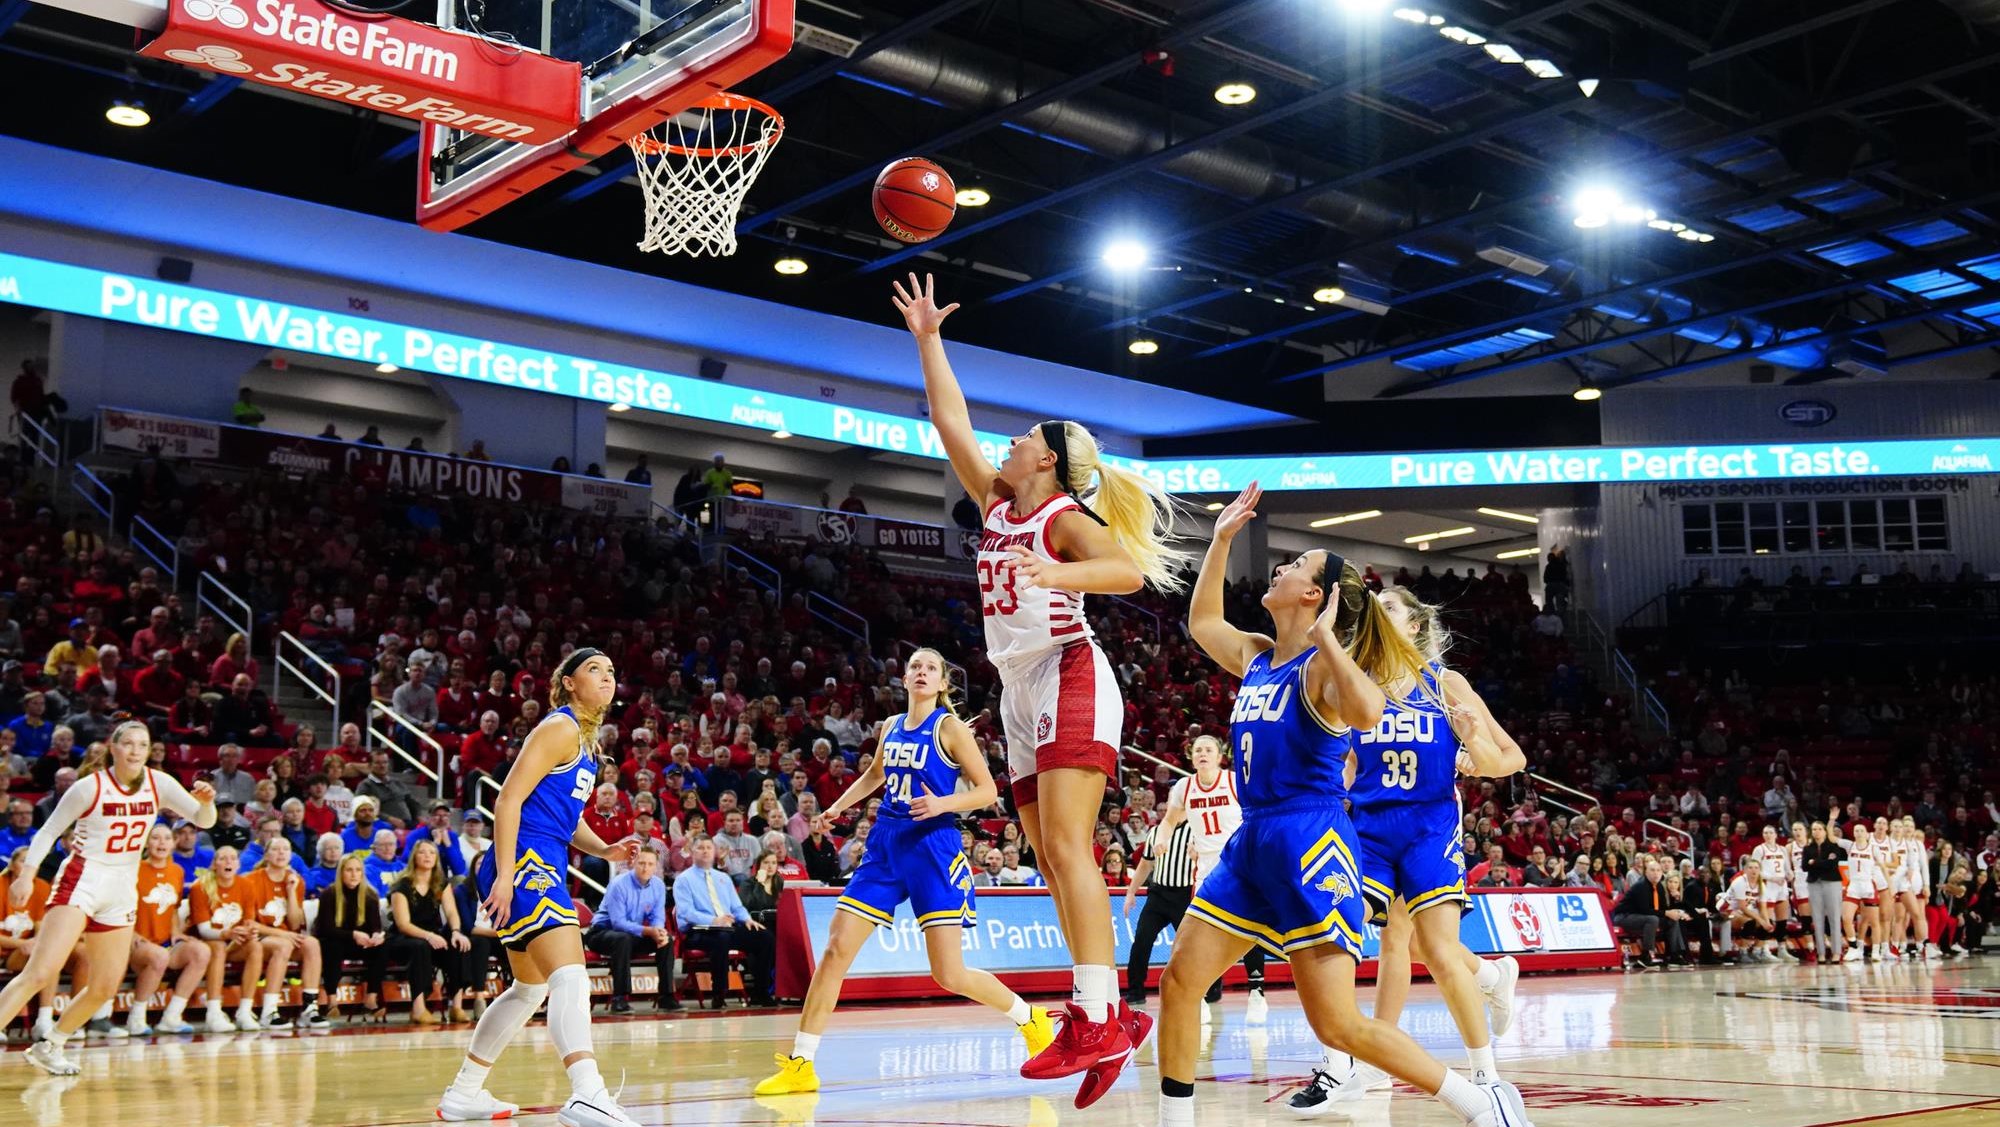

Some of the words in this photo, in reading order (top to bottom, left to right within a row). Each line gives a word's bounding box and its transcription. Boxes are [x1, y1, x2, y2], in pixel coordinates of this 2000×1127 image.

[102, 275, 220, 333] Pure
[235, 299, 389, 363] Water.
[404, 330, 559, 392] Perfect
[570, 359, 682, 413] Taste.
[820, 385, 836, 398] 107
[833, 407, 907, 450] Pure
[343, 447, 523, 502] CAMPIONS
[1391, 455, 1476, 485] Pure
[1487, 452, 1608, 483] Water.
[1621, 447, 1758, 479] Perfect
[1768, 445, 1880, 475] Taste.
[1658, 484, 1715, 499] MIDCO
[1718, 482, 1784, 497] SPORTS
[1790, 478, 1903, 495] PRODUCTION
[1909, 477, 1969, 493] BOOTH
[879, 528, 897, 546] GO
[900, 529, 941, 547] YOTES
[977, 559, 1019, 617] 23
[1240, 731, 1254, 786] 3
[1381, 749, 1418, 791] 33
[886, 772, 912, 805] 24
[106, 820, 147, 854] 22
[1202, 811, 1222, 836] 11
[986, 918, 1064, 950] Partn
